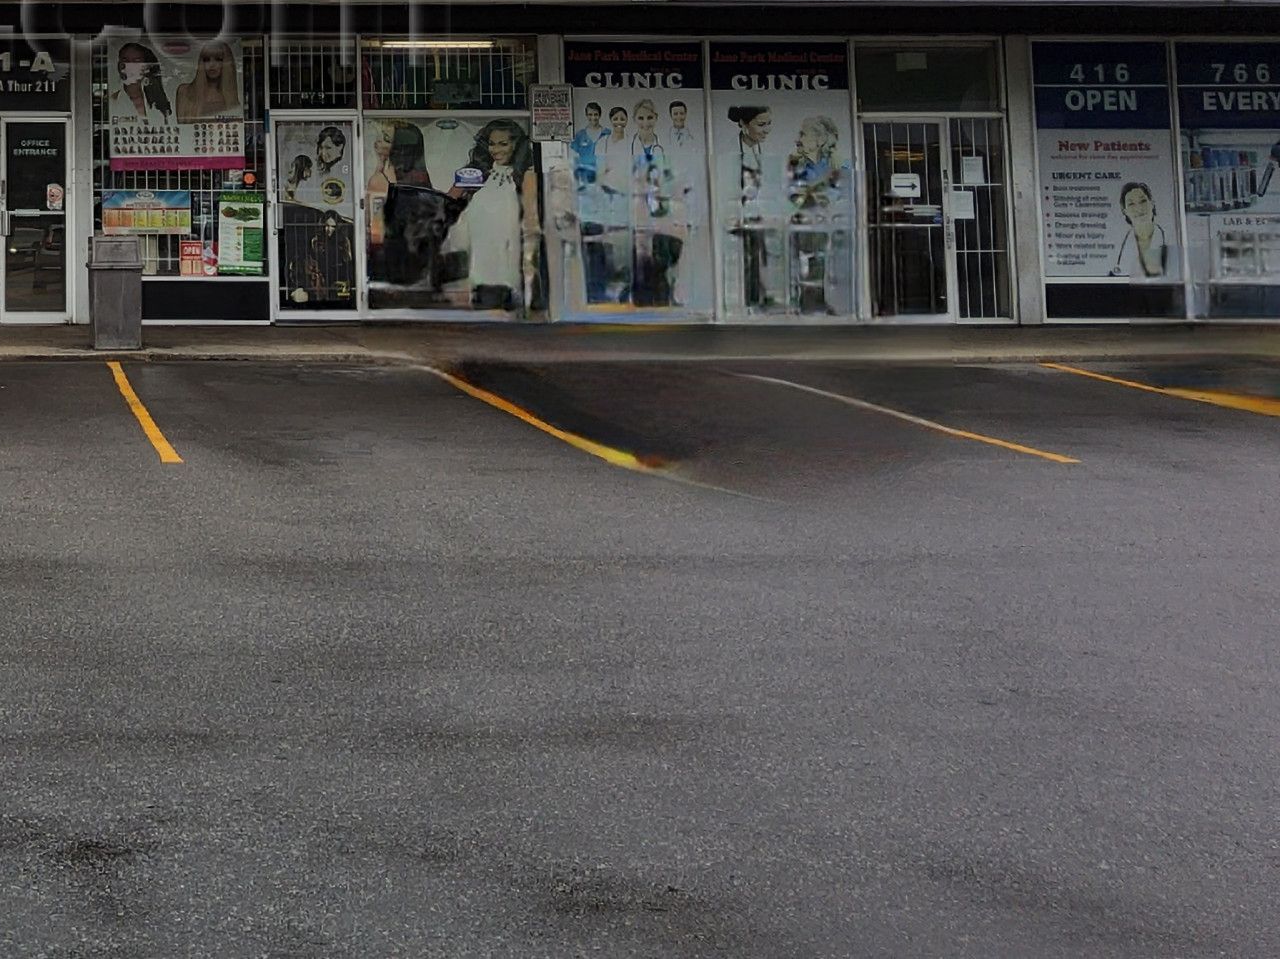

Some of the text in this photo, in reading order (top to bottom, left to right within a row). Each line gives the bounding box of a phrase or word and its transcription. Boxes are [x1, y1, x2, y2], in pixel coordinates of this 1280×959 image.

[567, 49, 594, 62] Jane
[594, 49, 620, 62] Park
[622, 49, 663, 62] Medical
[713, 51, 739, 64] Jane
[740, 51, 766, 64] Park
[768, 51, 808, 64] Medical
[584, 71, 683, 89] CLINIC
[1069, 63, 1131, 84] 416
[6, 79, 33, 93] Thur
[35, 79, 57, 93] 211
[730, 73, 830, 91] CLINIC
[1064, 89, 1139, 112] OPEN
[1202, 90, 1280, 112] EVERY
[20, 139, 52, 147] OFFICE
[1057, 140, 1152, 154] New Patients
[12, 147, 59, 157] ENTRANCE
[1052, 172, 1123, 182] URGENT CARE
[183, 246, 200, 256] OPEN
